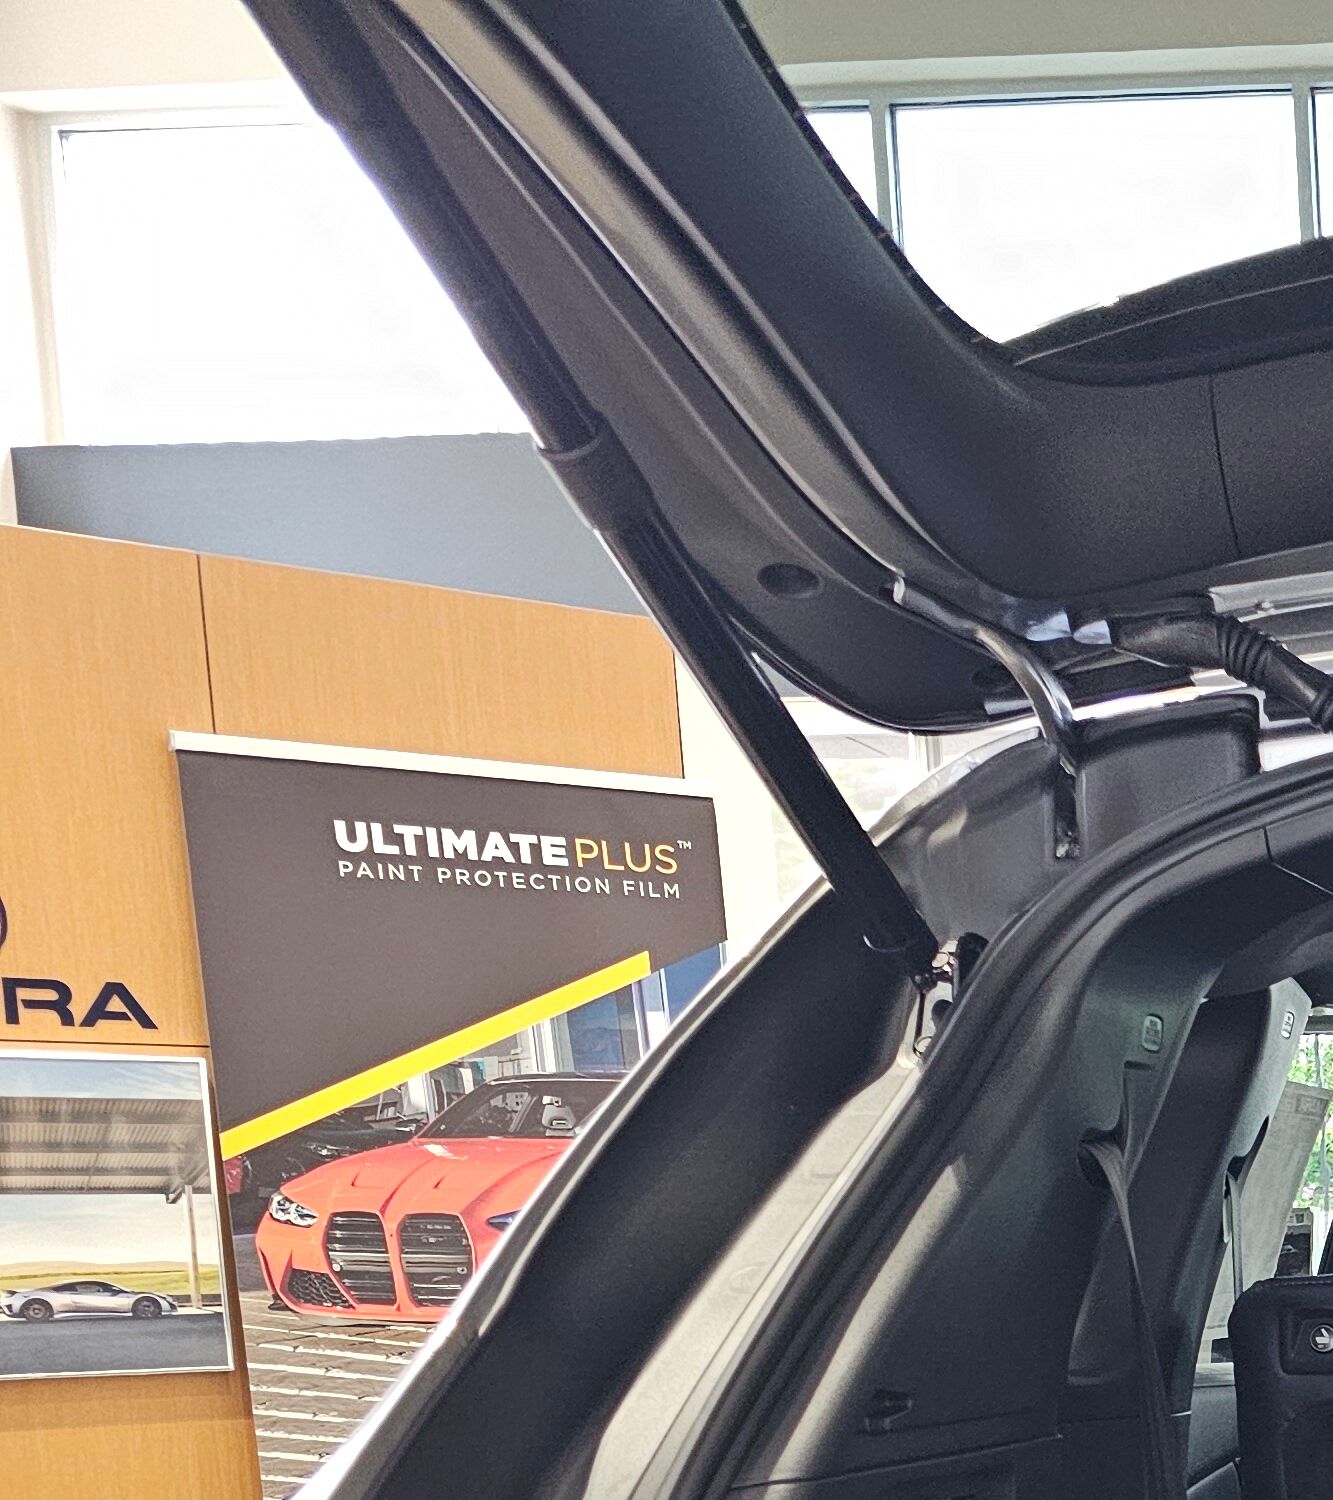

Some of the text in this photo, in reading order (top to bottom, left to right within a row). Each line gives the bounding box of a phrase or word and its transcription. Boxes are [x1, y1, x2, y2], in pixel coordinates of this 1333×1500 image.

[338, 860, 681, 899] PAINT PROTECTION FILM
